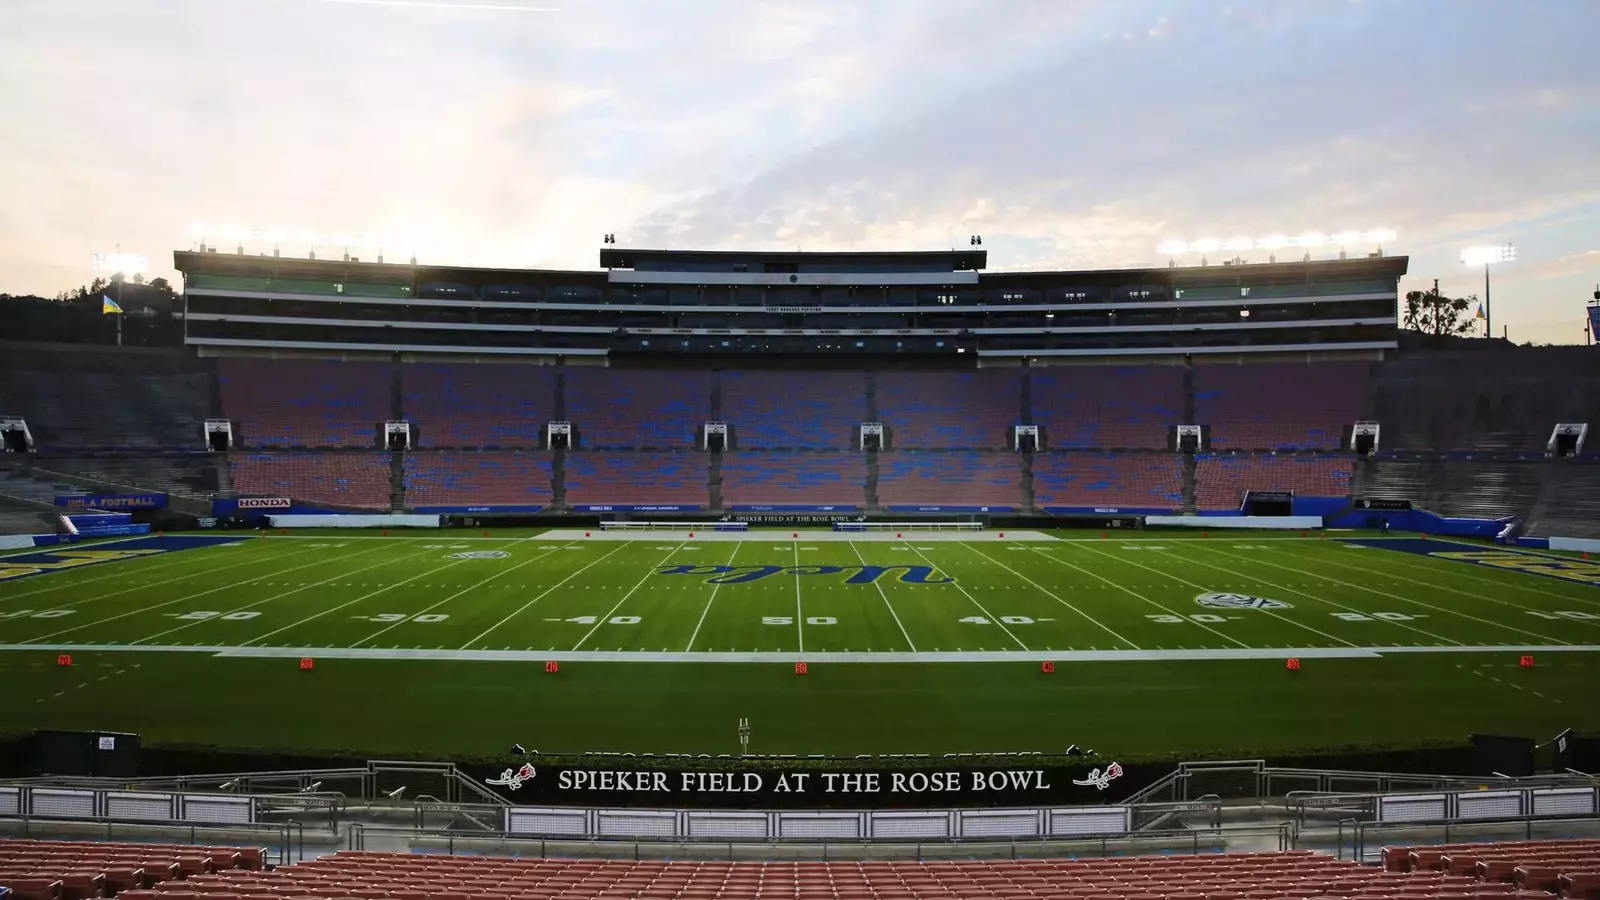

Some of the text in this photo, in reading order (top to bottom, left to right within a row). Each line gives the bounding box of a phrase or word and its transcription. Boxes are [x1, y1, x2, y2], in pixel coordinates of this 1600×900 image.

[100, 497, 155, 507] FOOTBALL
[240, 499, 289, 507] HONDA
[565, 616, 642, 625] 40
[761, 616, 838, 625] 50
[958, 616, 1036, 625] 40
[558, 771, 1051, 792] SPIEKER FIELD AT THE ROSE BOWL
